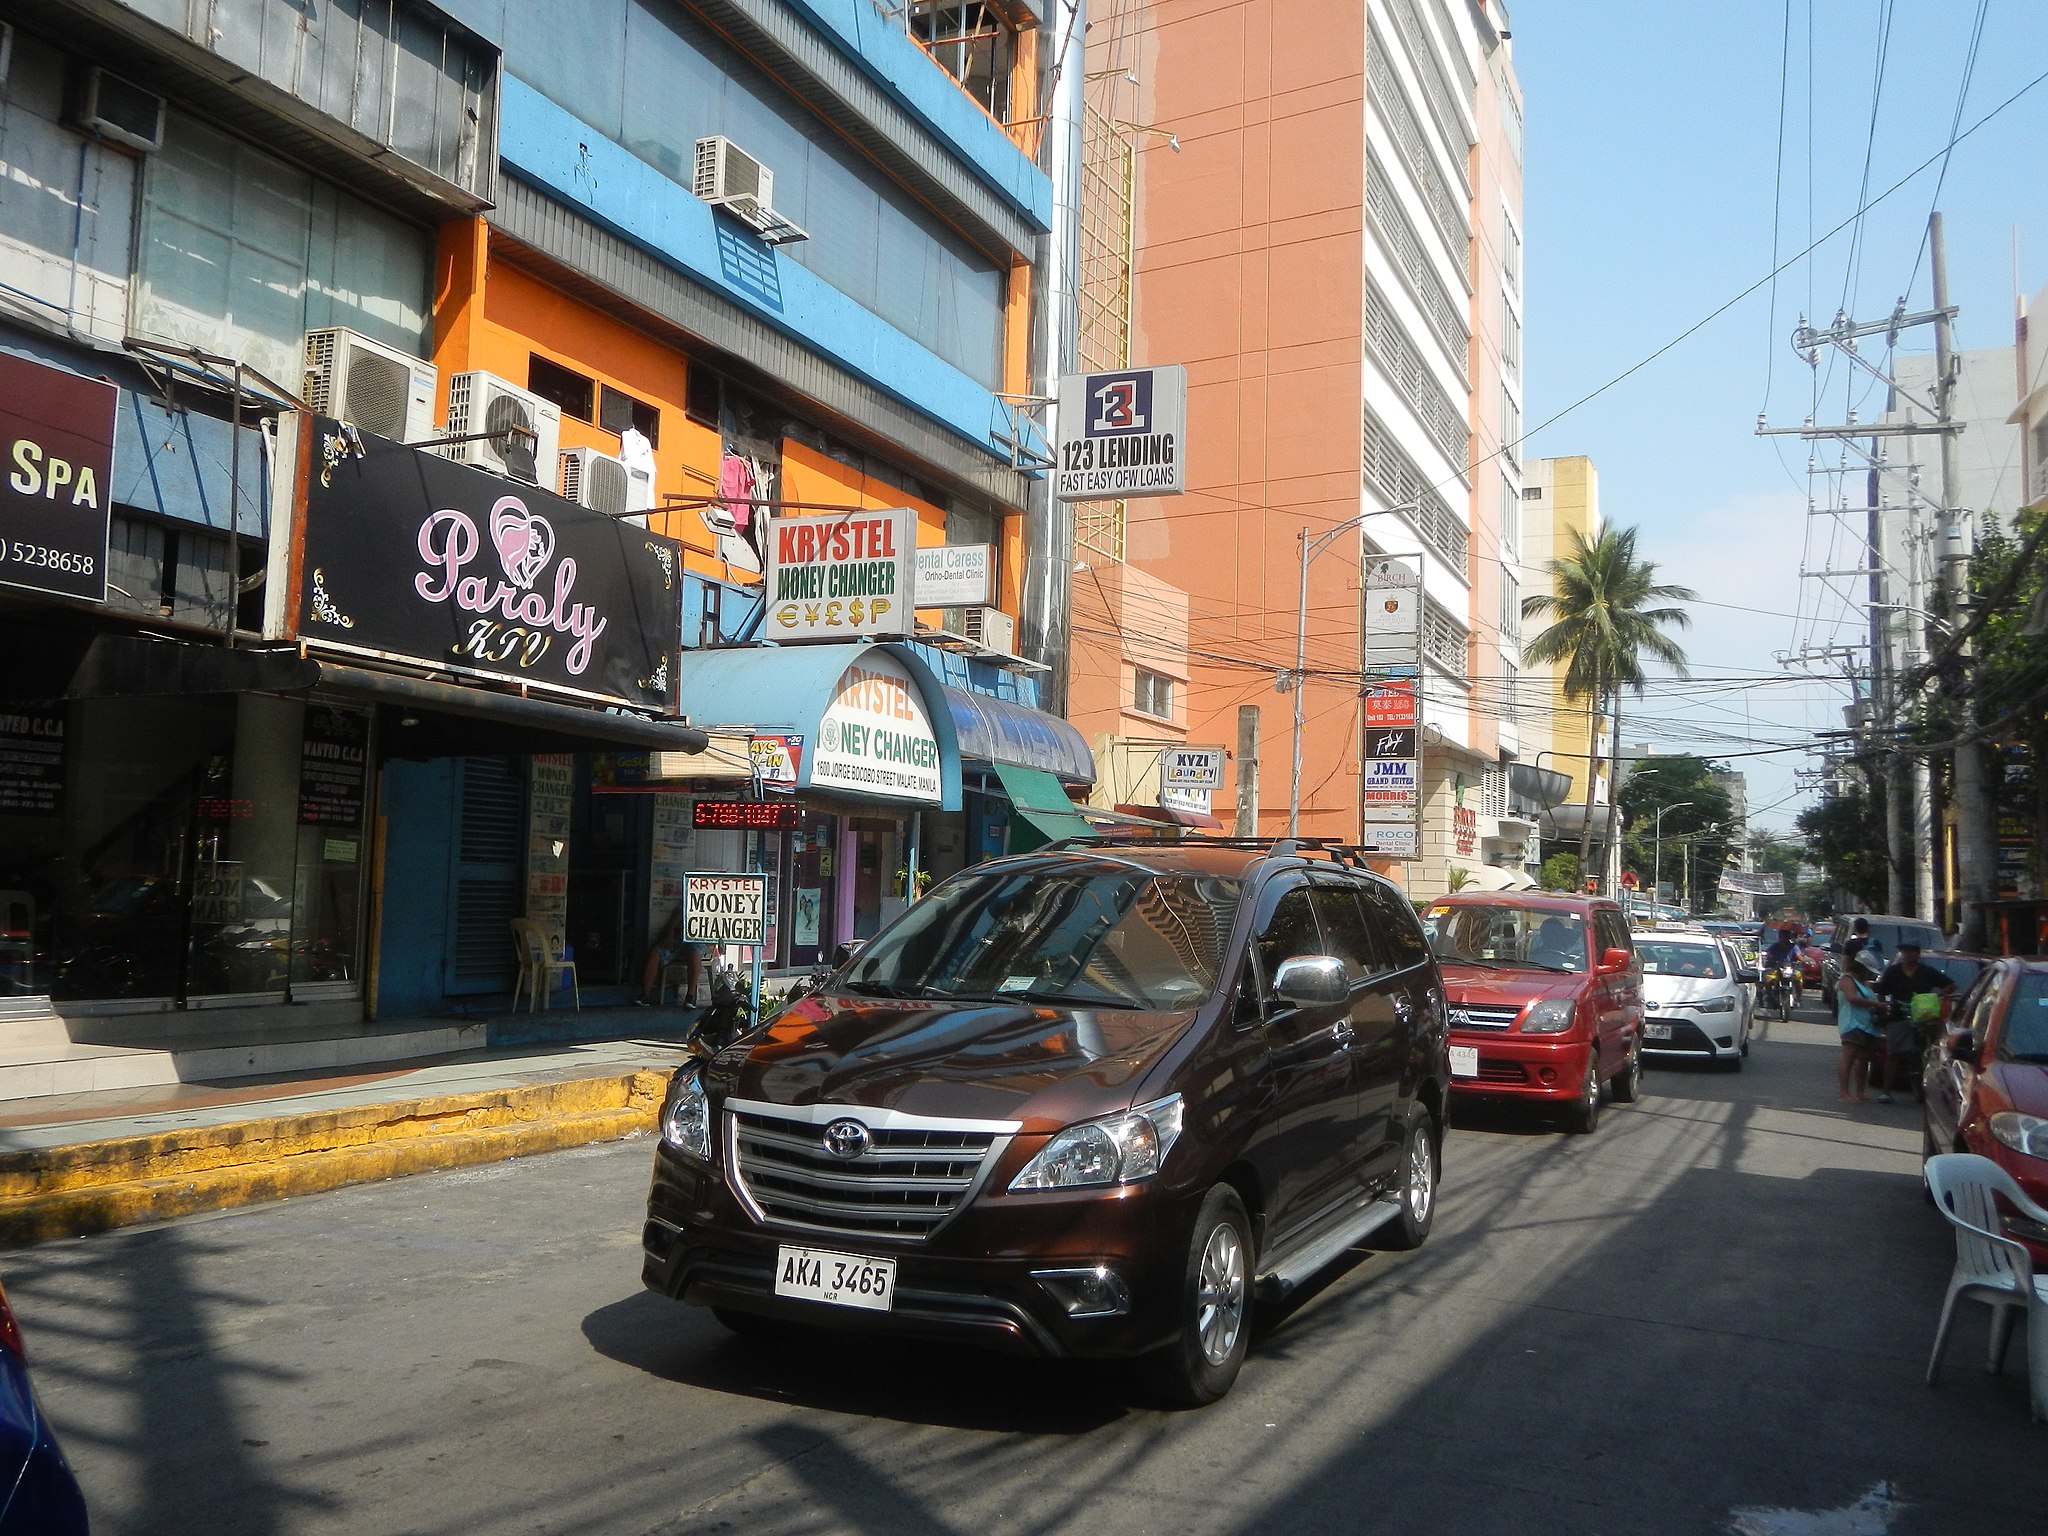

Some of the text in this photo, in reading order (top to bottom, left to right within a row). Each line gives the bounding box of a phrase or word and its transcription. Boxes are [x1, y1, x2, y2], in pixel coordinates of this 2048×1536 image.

[1063, 433, 1174, 471] 123 LENDING
[1060, 466, 1174, 492] FAST EASY OFW LOANS
[778, 519, 896, 564] KRYSTEL
[12, 542, 94, 575] 5238658
[947, 549, 984, 568] Caress
[778, 565, 826, 600] MONEY
[828, 561, 896, 598] CHANGER
[925, 568, 984, 581] Ortho-Dental Clinic
[414, 509, 608, 676] Paroly
[452, 619, 552, 669] KTV
[837, 666, 913, 721] KRYSTEL
[304, 741, 341, 760] WANTED
[874, 729, 937, 769] CHANGER
[831, 762, 851, 780] JORGE
[876, 769, 897, 786] STREET
[918, 777, 937, 793] MANILA
[1170, 767, 1214, 779] Laundry
[1374, 762, 1407, 775] JMM
[1367, 777, 1414, 785] GRAND SUITES
[1366, 791, 1408, 800] MORRIS
[690, 878, 761, 891] KRYSTEL
[689, 893, 761, 914] MONEY
[688, 917, 761, 939] CHANGER
[783, 1257, 888, 1297] AKA 3465
[823, 1291, 838, 1300] NCR
